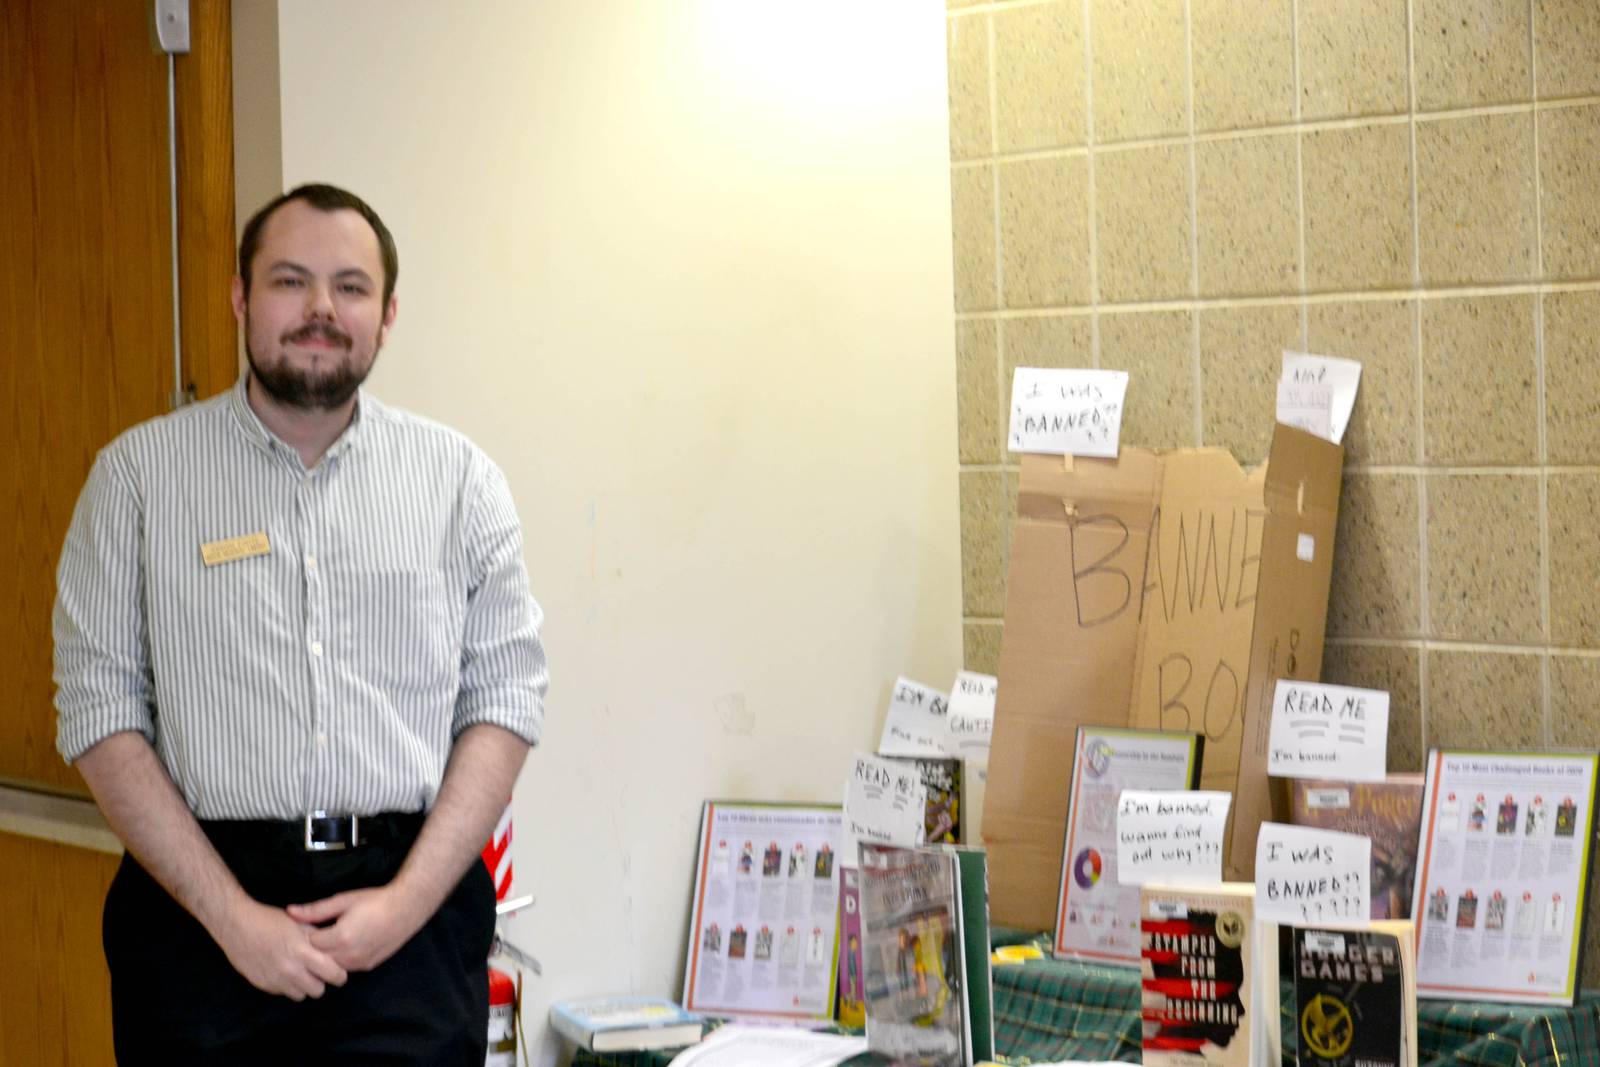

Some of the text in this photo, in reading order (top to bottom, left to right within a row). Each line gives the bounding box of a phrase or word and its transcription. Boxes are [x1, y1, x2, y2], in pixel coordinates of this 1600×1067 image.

[1159, 652, 1248, 743] BO
[1284, 687, 1367, 720] READ ME
[854, 759, 890, 788] READ
[1266, 841, 1334, 865] I WAS
[1155, 932, 1216, 958] STAMPED
[1181, 955, 1216, 980] FROM
[1300, 959, 1384, 983] GAMES
[1190, 978, 1217, 1002] THE
[1166, 998, 1238, 1027] BEGINNING
